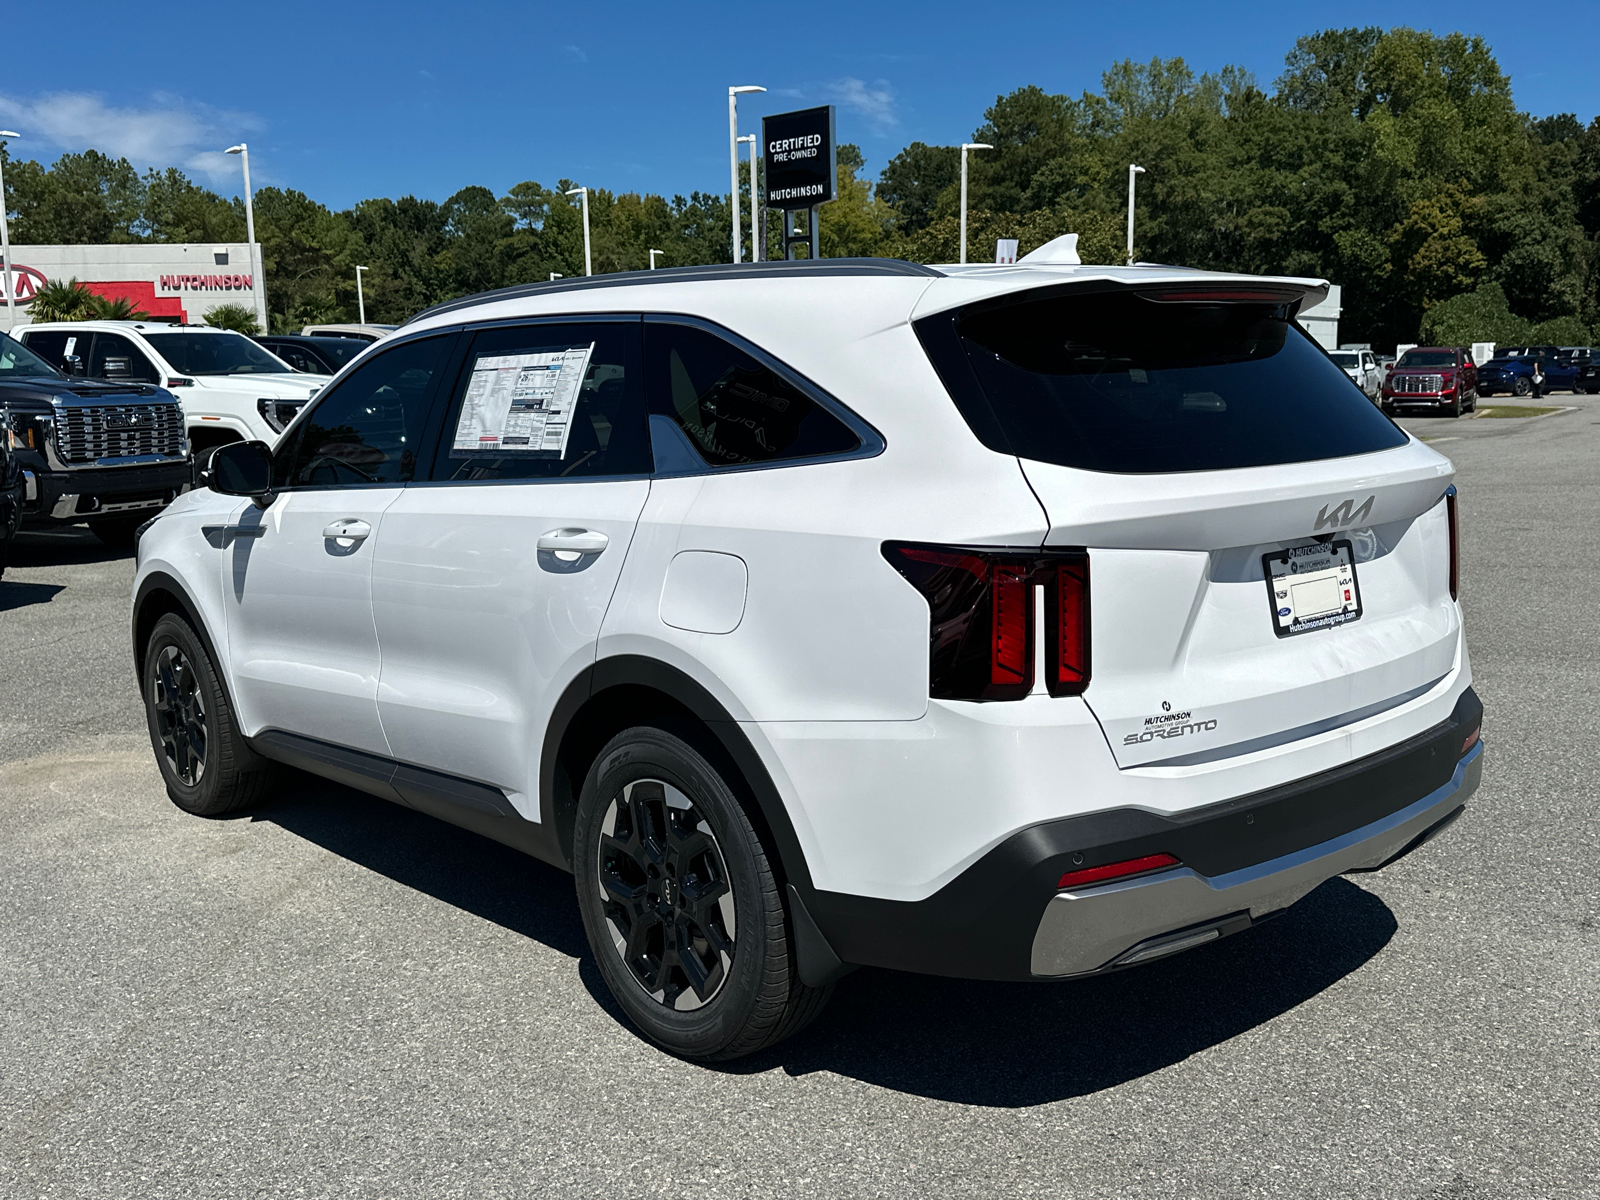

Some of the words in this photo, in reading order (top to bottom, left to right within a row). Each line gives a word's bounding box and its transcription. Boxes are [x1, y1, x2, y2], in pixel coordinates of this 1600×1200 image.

[769, 134, 821, 153] CERTIFIED
[773, 148, 818, 163] PRE-OWNED
[770, 184, 823, 200] HUTCHINSON
[160, 274, 253, 289] HUTCHINSON
[107, 414, 154, 428] GMC
[1313, 495, 1375, 530] KIA
[1295, 542, 1333, 557] HUTCHINSON
[1289, 611, 1357, 633] Hutchinsonautogroup.com
[1144, 711, 1192, 726] HUTCHINSON
[1123, 719, 1218, 746] SORENTO
[1144, 722, 1174, 731] AUTOMOTIVE
